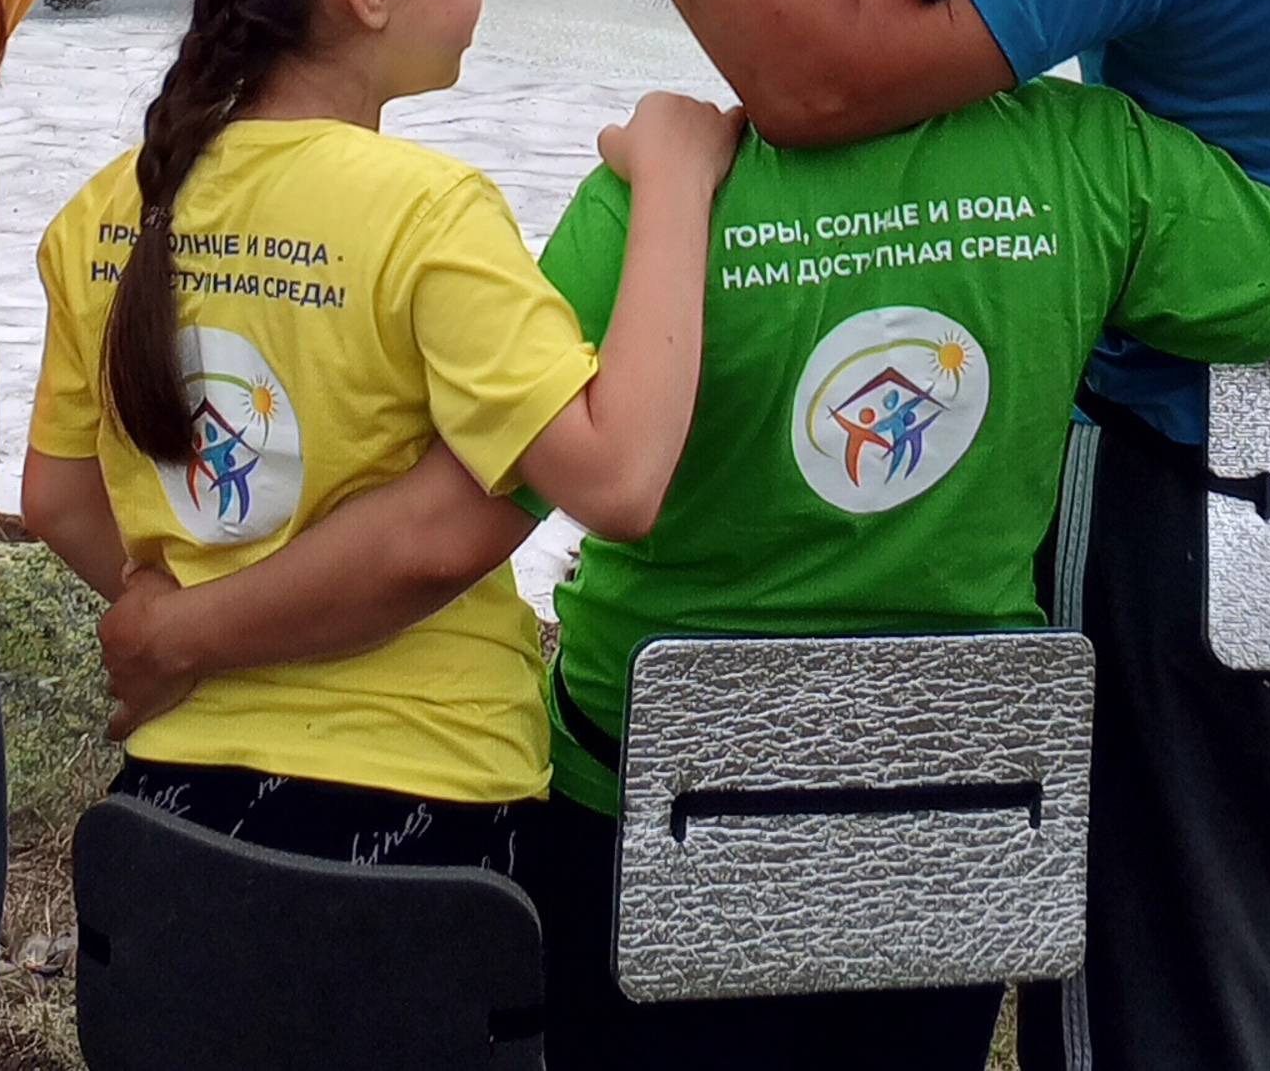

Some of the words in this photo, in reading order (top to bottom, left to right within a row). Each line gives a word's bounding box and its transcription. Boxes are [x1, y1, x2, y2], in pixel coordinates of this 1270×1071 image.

[724, 219, 810, 250] ГОРЫ,
[815, 203, 920, 240] СОЛНЦЕ
[929, 200, 949, 224] И
[957, 195, 1035, 221] ВОДА
[168, 232, 240, 259] ОЛНЦЕ
[247, 234, 259, 258] И
[264, 237, 329, 267] ВОДА
[722, 261, 790, 290] НАМ
[797, 240, 953, 286] ДОСТУПНАЯ
[961, 233, 1058, 262] СРЕДА!
[263, 276, 347, 309] СРЕДА!
